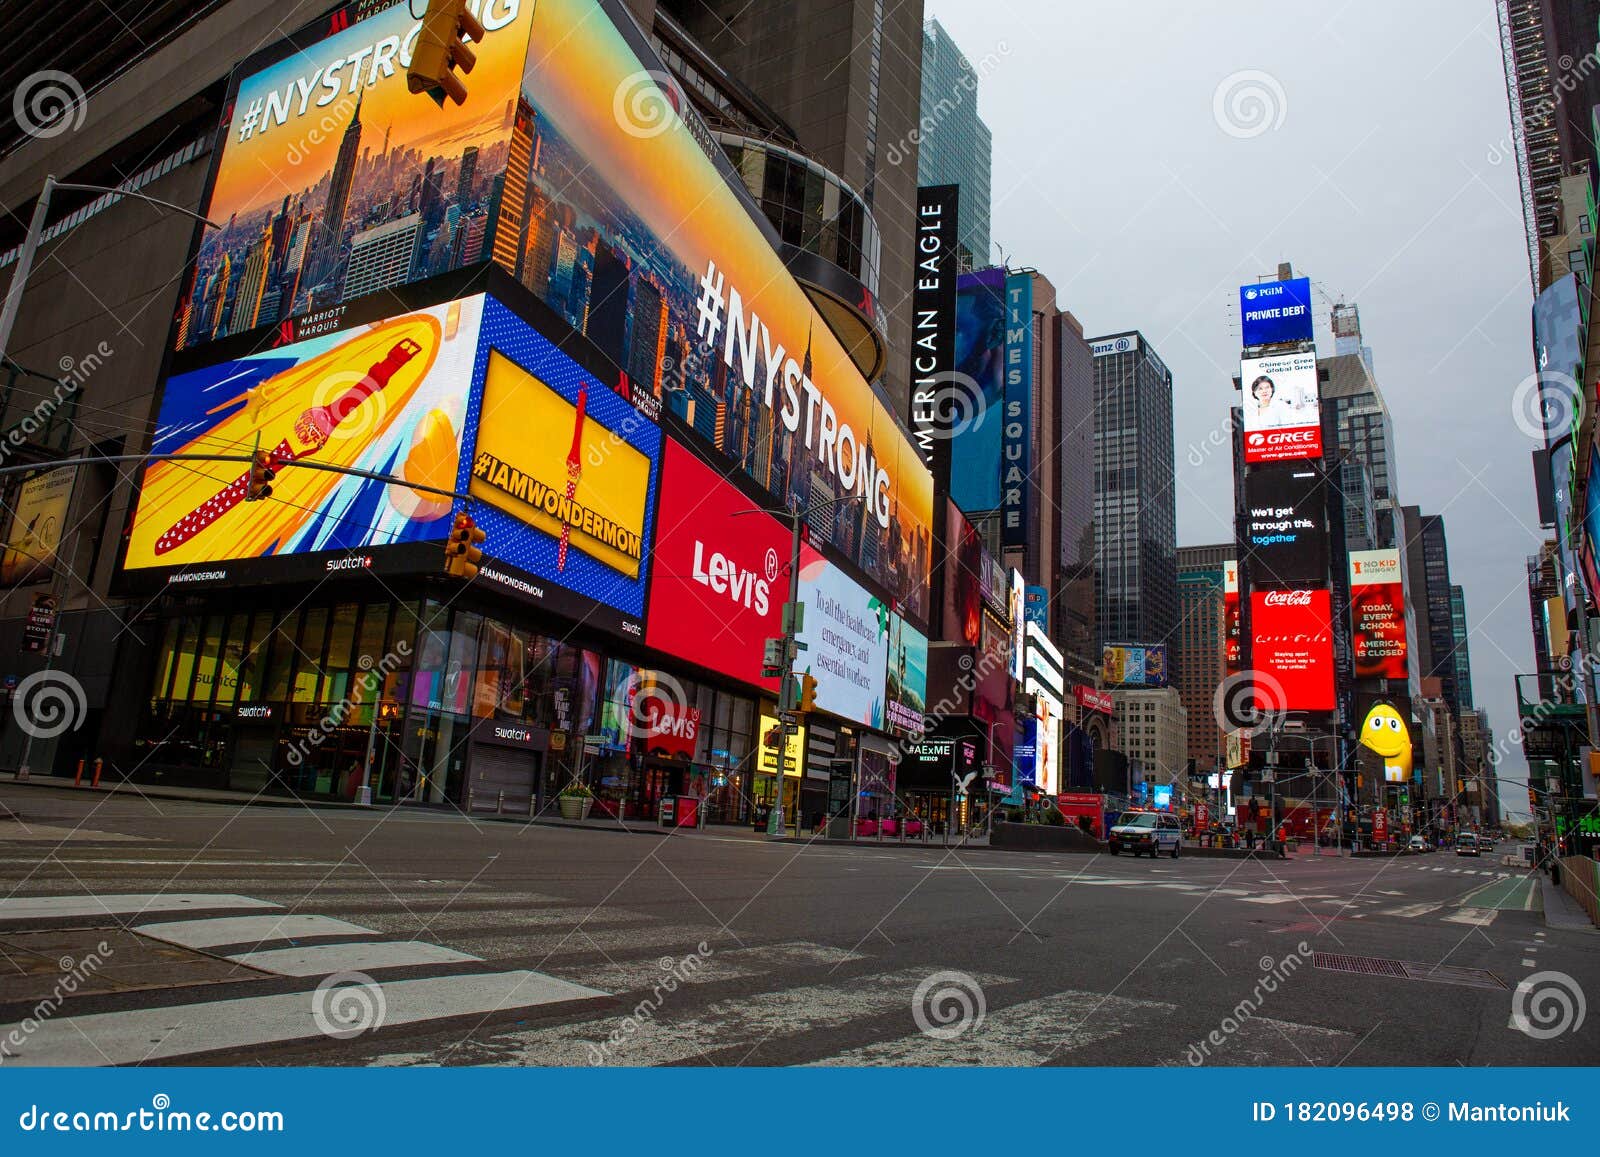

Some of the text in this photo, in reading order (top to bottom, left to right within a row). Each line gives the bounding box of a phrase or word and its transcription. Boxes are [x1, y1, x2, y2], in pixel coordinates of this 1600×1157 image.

[918, 203, 942, 290] EAGLE
[1259, 286, 1283, 297] PGIM
[300, 305, 347, 327] MARRIOTT
[1246, 304, 1306, 322] PRIVATE DEBT
[298, 319, 339, 338] MARQUIS
[1007, 287, 1023, 386] TIMES
[1259, 360, 1291, 369] Chinese
[1266, 366, 1292, 374] Global
[633, 383, 663, 412] MARRIOTT
[696, 259, 890, 529] #NYSTRONG
[912, 310, 938, 476] MERICAN
[632, 395, 659, 422] MARQUIS
[1266, 430, 1316, 445] GREE
[1284, 442, 1319, 451] Conditioning
[1260, 450, 1308, 459] www.gree.com
[1005, 400, 1022, 529] SQUARE
[473, 450, 641, 559] #IAMWONDERMOM
[1251, 506, 1293, 519] We'll get
[1251, 518, 1315, 531] through this,
[1252, 533, 1297, 546] together
[326, 556, 365, 571] swatch
[1364, 566, 1397, 574] HUNGRY
[479, 566, 544, 599] #IAMWONDERMOM
[815, 588, 825, 611] To
[824, 597, 834, 618] all
[834, 602, 845, 625] the
[1361, 604, 1394, 612] TODAY,
[1362, 613, 1393, 621] EVERY
[1359, 622, 1398, 630] SCHOOL
[1374, 631, 1384, 639] IN
[1359, 639, 1401, 648] AMERICA
[857, 648, 870, 665] and
[1367, 648, 1404, 657] CLOSED
[816, 651, 846, 680] essential
[238, 706, 267, 717] swatch
[495, 727, 527, 742] swatch
[909, 745, 951, 756] #AExME
